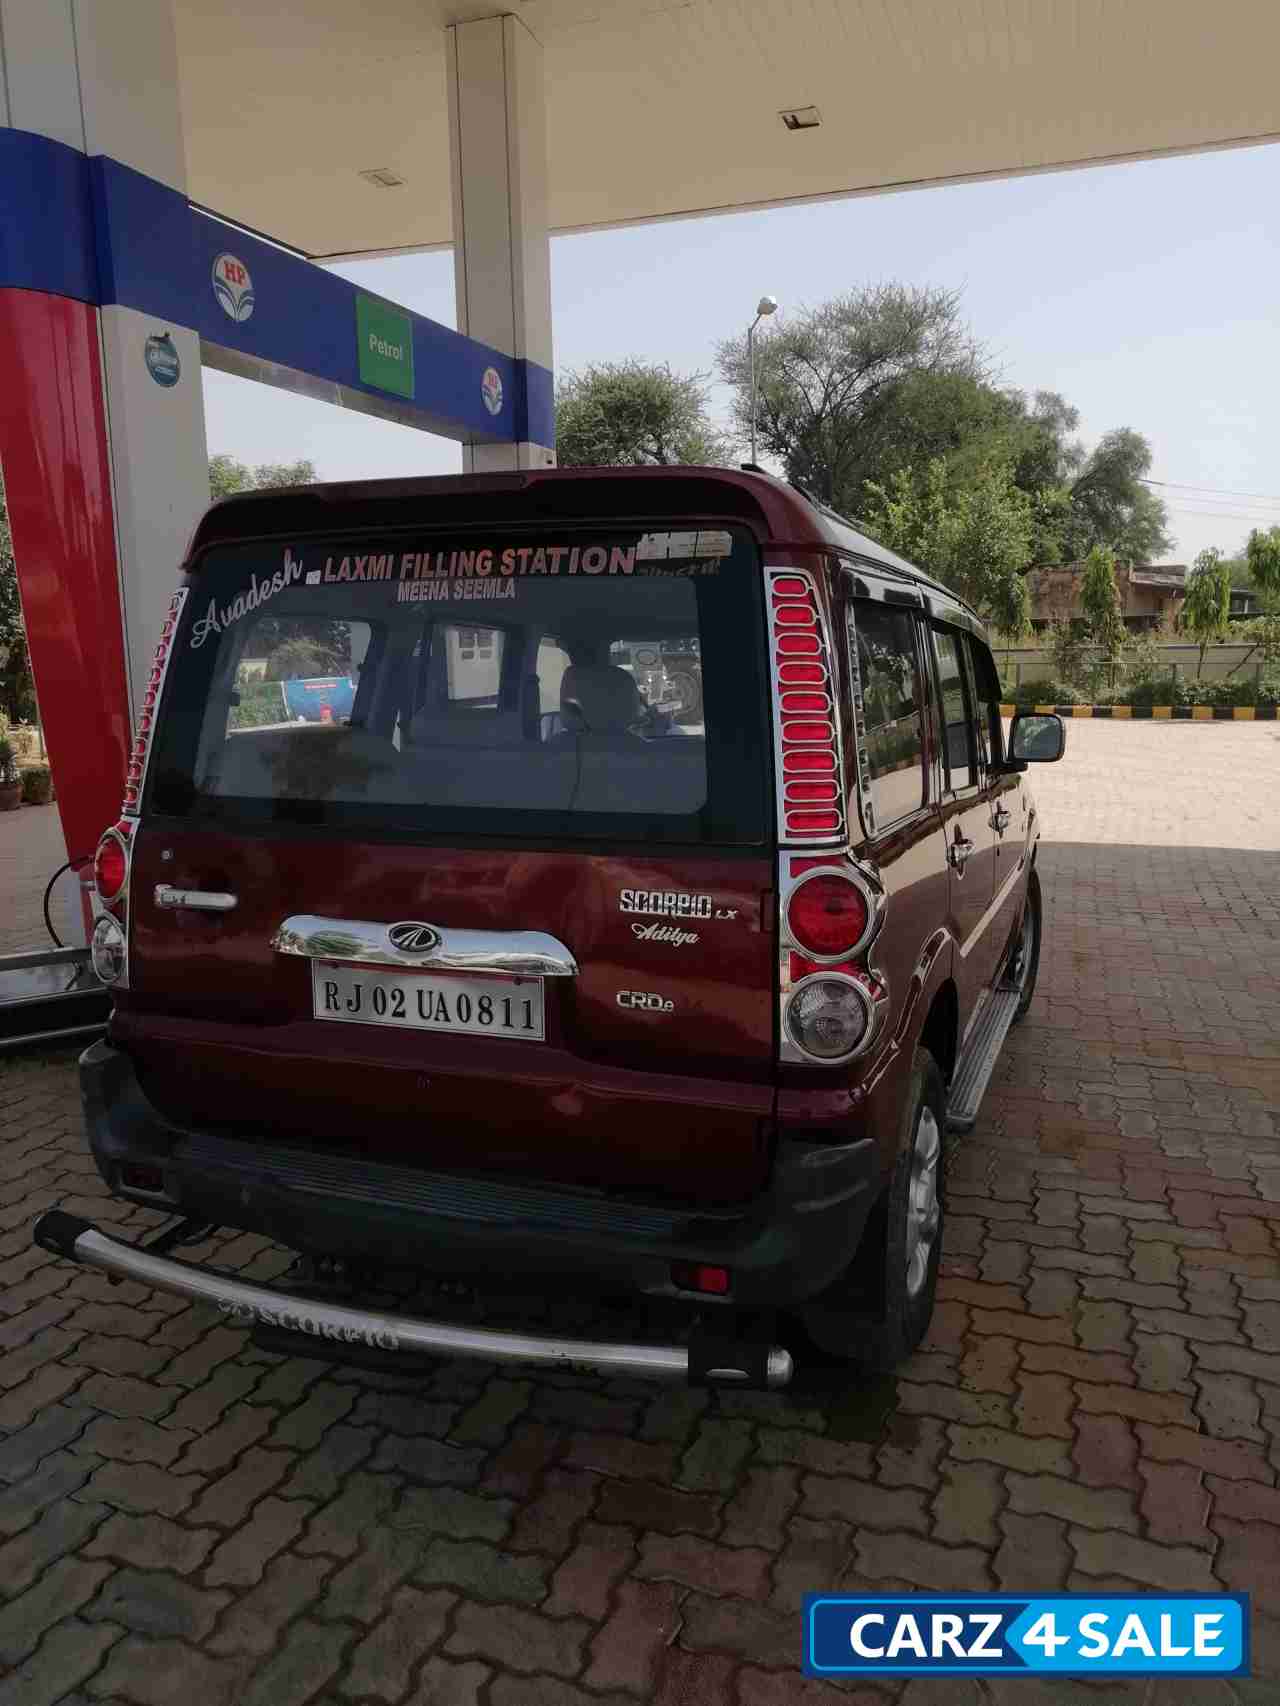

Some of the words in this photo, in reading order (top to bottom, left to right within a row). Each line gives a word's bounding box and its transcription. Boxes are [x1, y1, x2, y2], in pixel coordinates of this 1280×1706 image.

[368, 333, 403, 360] Petrol
[324, 554, 394, 582] LAXMI
[399, 550, 493, 580] FILLING
[500, 546, 636, 577] STATION
[453, 577, 516, 600] SEEMLA
[619, 888, 712, 919] SCORPIO
[631, 922, 700, 947] Aditya
